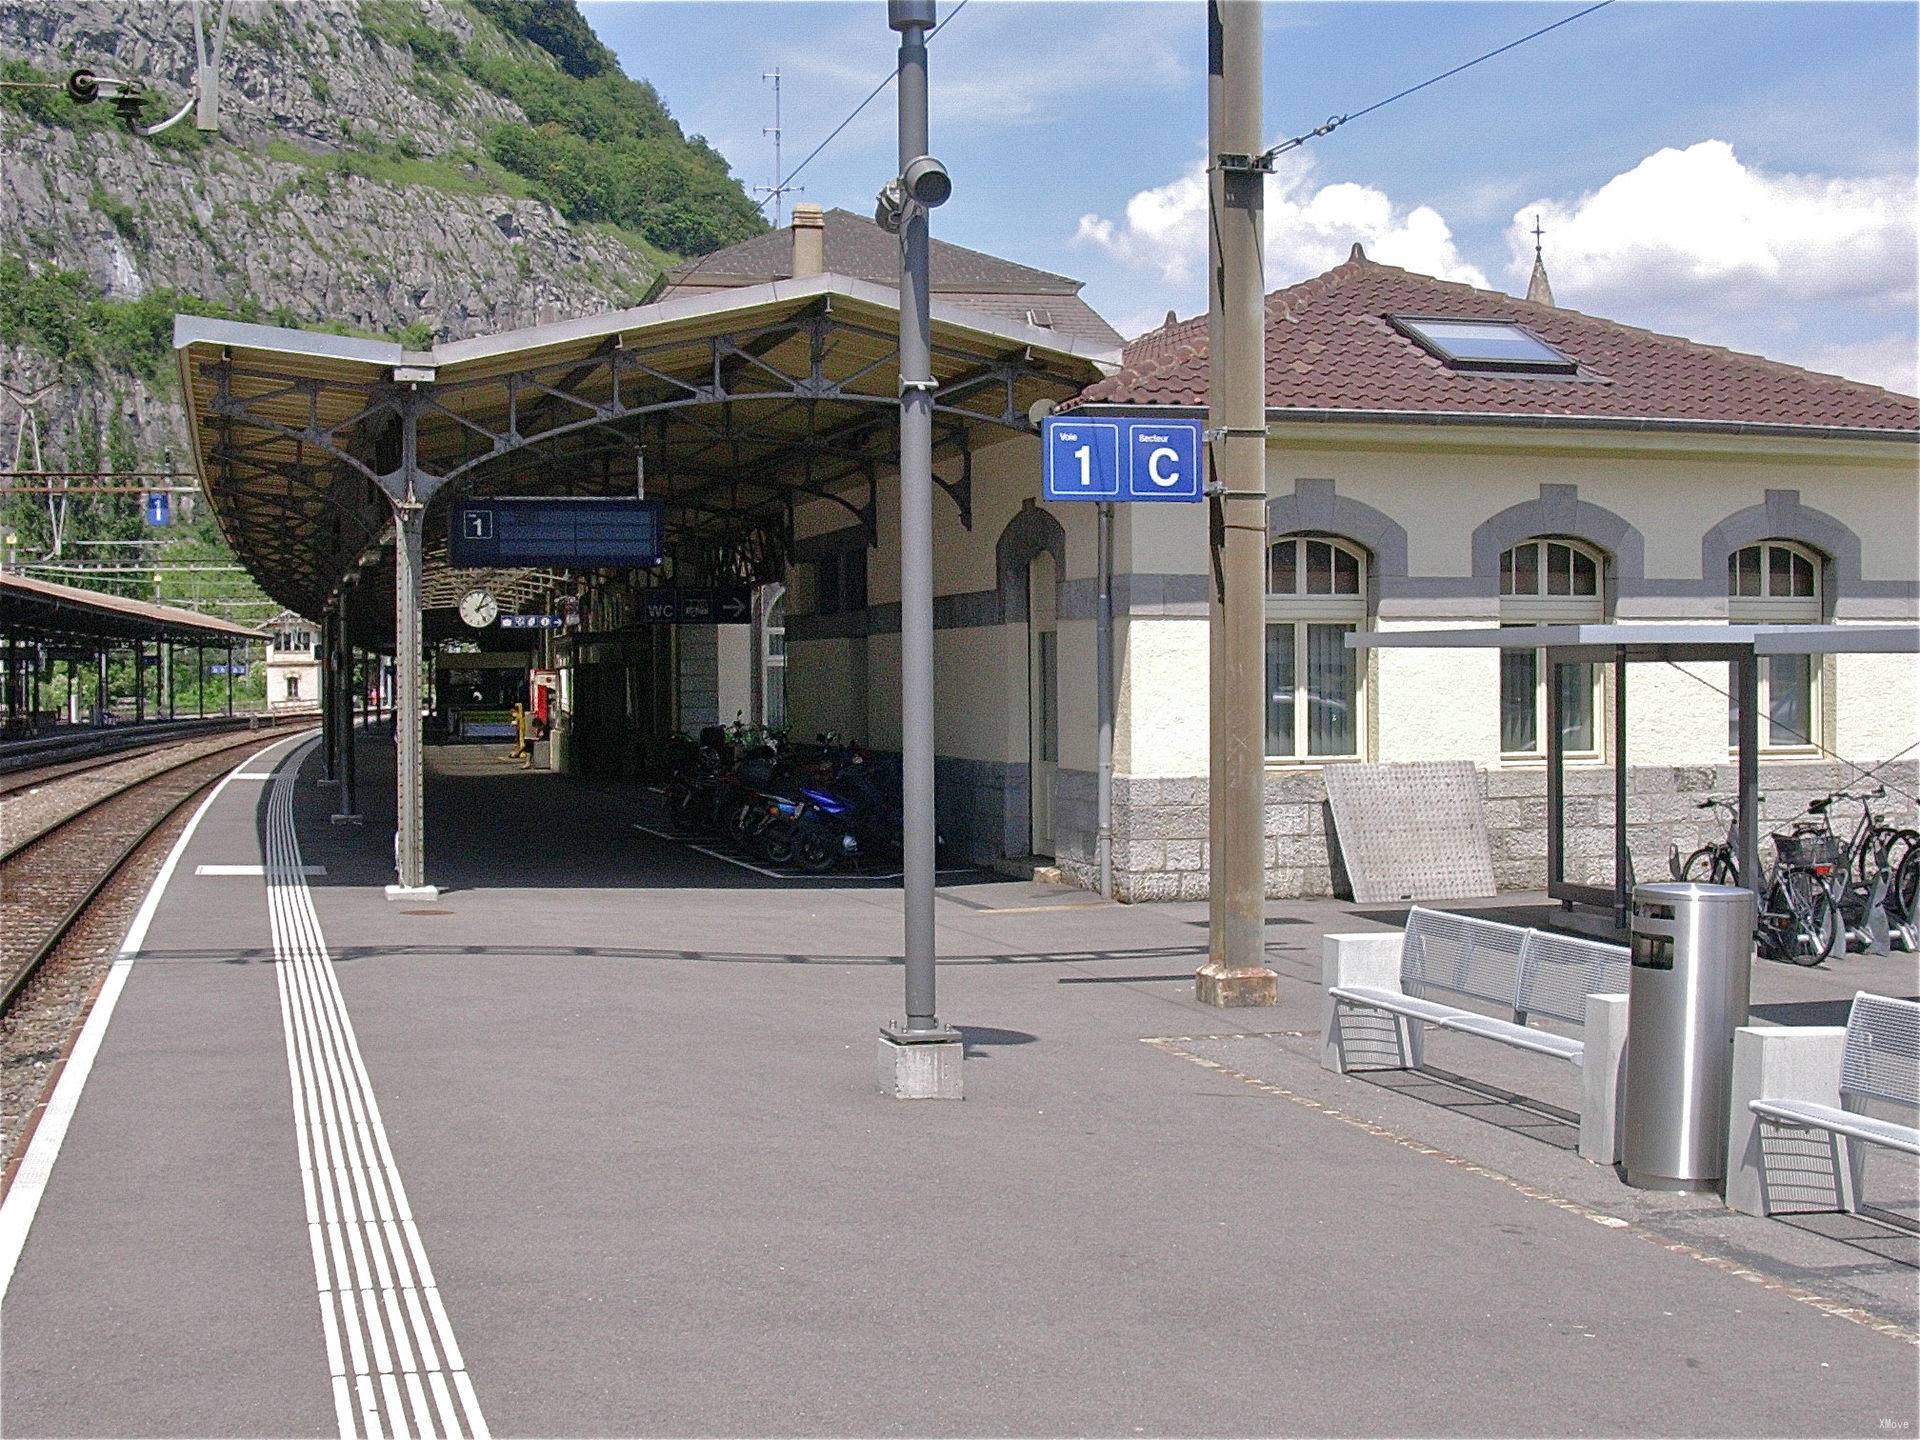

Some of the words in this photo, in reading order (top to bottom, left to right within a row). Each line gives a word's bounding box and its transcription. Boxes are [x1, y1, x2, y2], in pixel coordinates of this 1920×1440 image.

[1059, 432, 1078, 442] Voie
[1138, 434, 1170, 443] Secteur
[1074, 445, 1090, 486] 1
[1148, 447, 1180, 487] C
[473, 518, 482, 536] 1
[648, 604, 673, 617] WC
